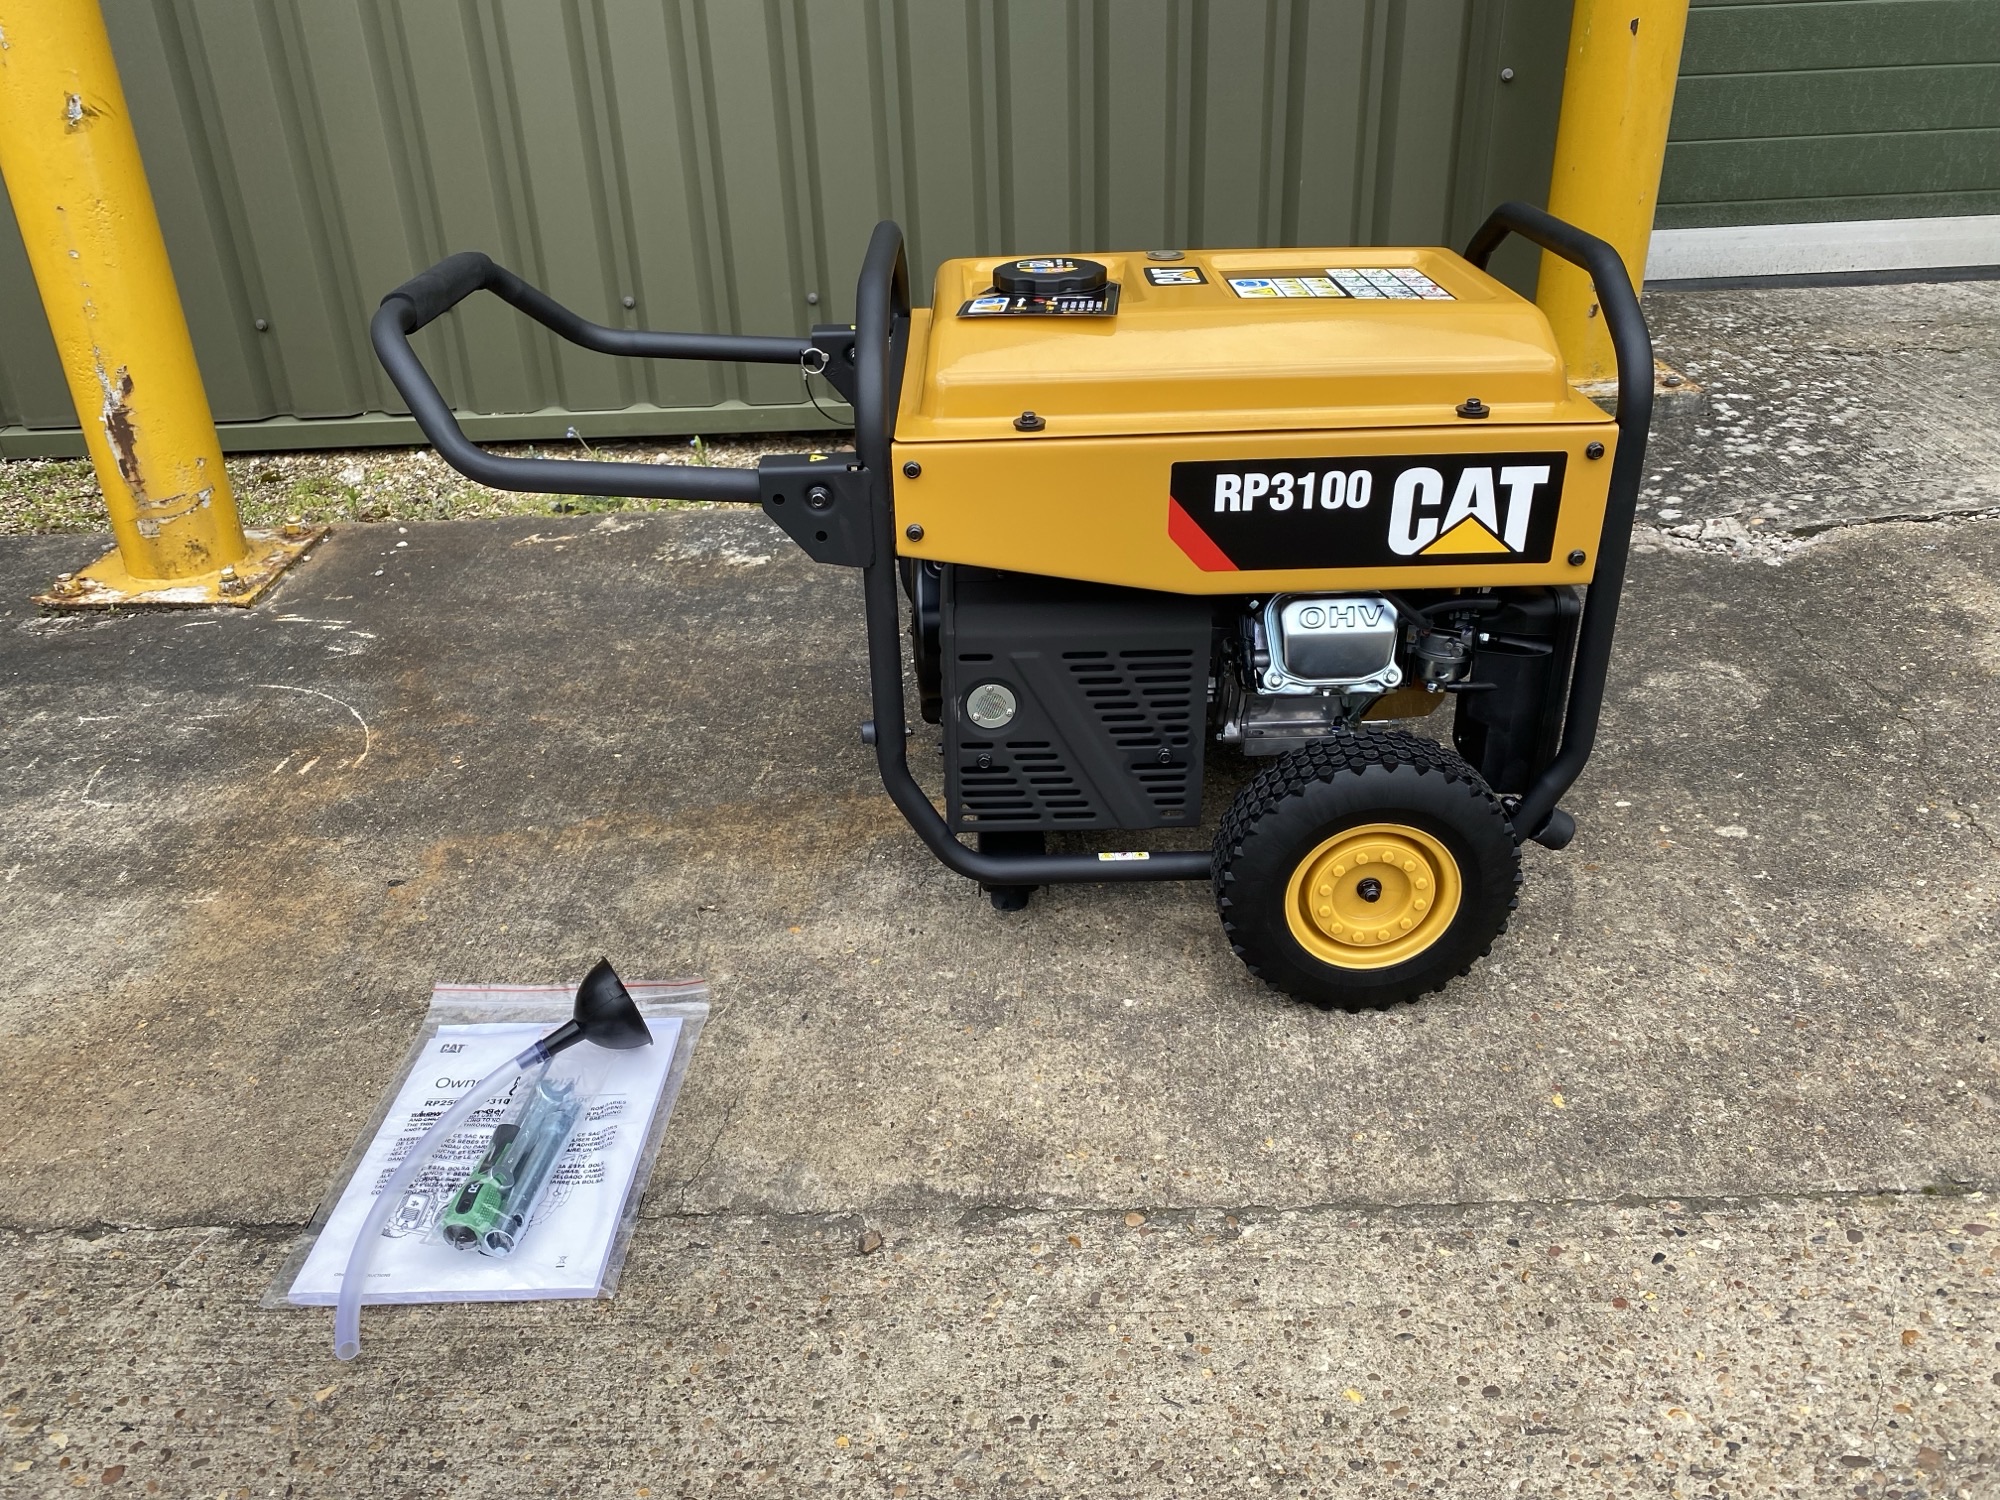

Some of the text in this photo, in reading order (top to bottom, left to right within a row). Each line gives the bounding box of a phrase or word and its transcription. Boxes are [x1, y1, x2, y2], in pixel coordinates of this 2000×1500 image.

[1150, 268, 1201, 284] CAT
[1214, 465, 1551, 556] RP3100 CAT
[1299, 604, 1385, 629] OHV
[440, 1044, 464, 1054] CAT
